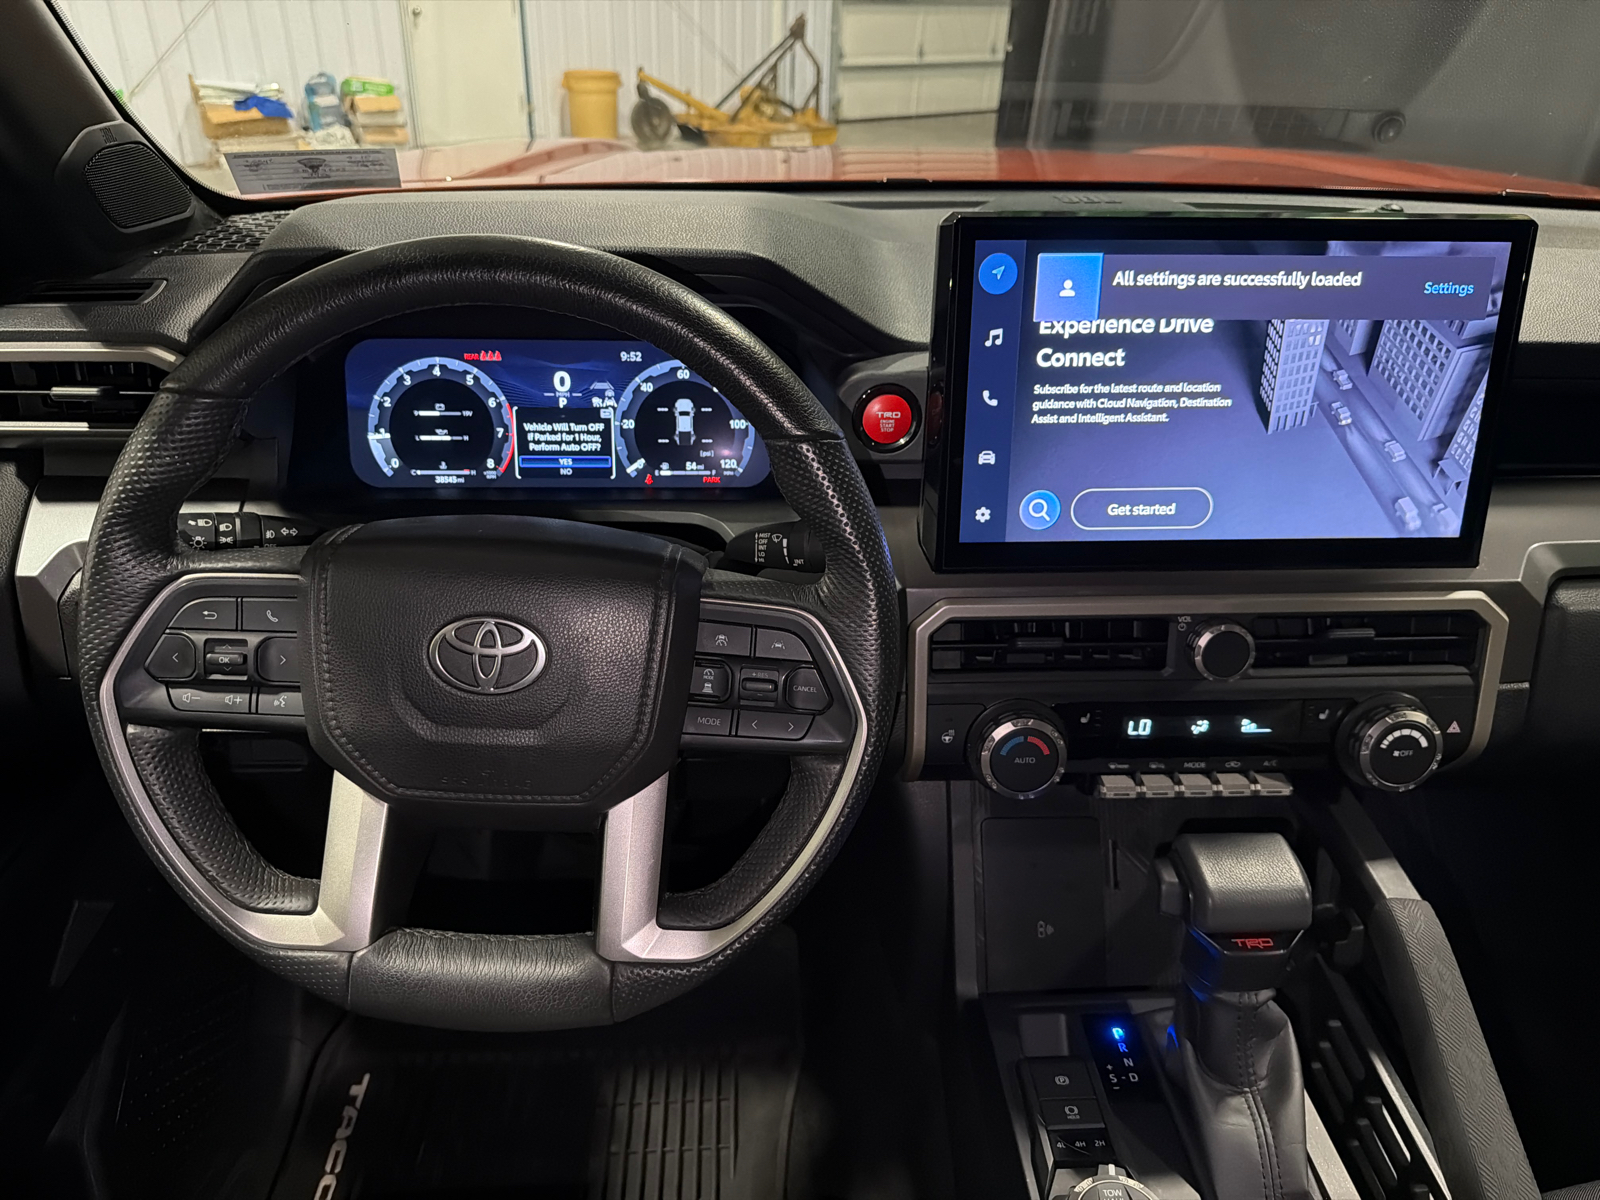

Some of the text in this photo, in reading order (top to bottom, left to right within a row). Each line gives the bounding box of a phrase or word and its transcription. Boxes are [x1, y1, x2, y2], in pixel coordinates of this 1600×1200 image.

[1112, 270, 1362, 290] All settings are successfully loaded
[1424, 281, 1474, 297] Settings
[1039, 318, 1214, 339] Experience Drive
[620, 351, 642, 362] 9:52
[1036, 347, 1126, 367] Connect
[432, 366, 441, 376] 4
[677, 369, 690, 379] 60
[403, 375, 411, 385] 3
[466, 375, 474, 385] 5
[553, 371, 571, 392] 0
[640, 383, 653, 392] 40
[1033, 382, 1221, 394] Subscribe for the latest route and location
[383, 397, 391, 407] 2
[488, 397, 496, 407] 6
[559, 397, 567, 408] P
[1032, 397, 1232, 411] guidance with Cloud Navigation, Destination
[1031, 412, 1170, 424] Assist and Intelligent Assistant.
[523, 423, 604, 431] Vehicle Will Turn OFF
[622, 419, 635, 429] 20
[729, 419, 746, 429] 100
[496, 428, 504, 438] 7
[527, 433, 602, 442] If Parked for 1 Hour,
[529, 443, 601, 451] Perform Auto OFF?
[390, 458, 399, 468] 0
[487, 458, 495, 468] 8
[685, 462, 697, 470] 54
[720, 459, 736, 468] 120
[435, 476, 457, 484] 38545
[1107, 502, 1176, 516] Get started
[793, 685, 817, 693] CANCEL
[697, 717, 721, 726] MODE
[1127, 718, 1152, 735] LO
[1231, 938, 1273, 949] TRD
[1112, 1027, 1125, 1040] P
[1118, 1042, 1128, 1052] R
[1124, 1058, 1134, 1067] N
[1109, 1073, 1139, 1083] S D
[1102, 1189, 1122, 1197] TOW
